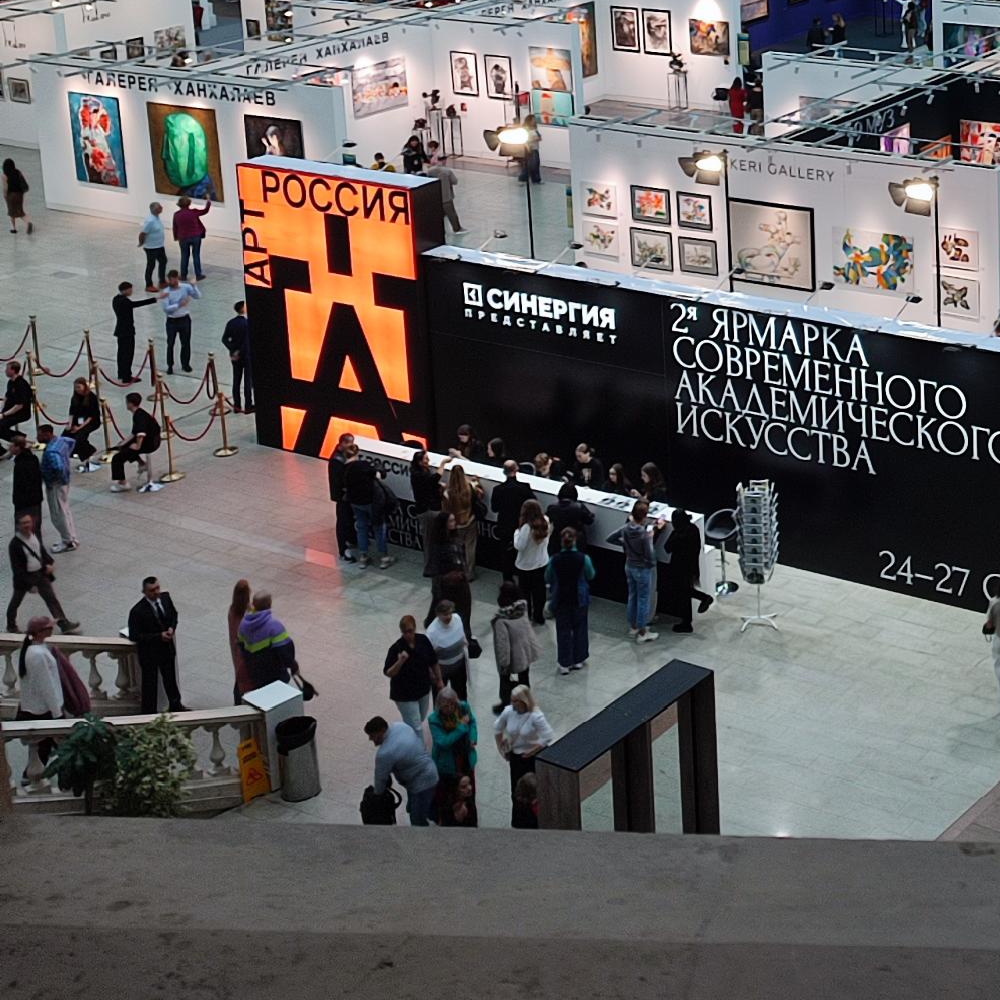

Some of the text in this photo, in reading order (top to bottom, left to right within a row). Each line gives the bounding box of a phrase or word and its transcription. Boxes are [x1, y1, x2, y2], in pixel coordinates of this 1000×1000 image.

[86, 70, 277, 106] ГАЛЕРЕЯ ХАНХАЛАЕВ
[261, 170, 410, 225] РОССИЯ
[767, 163, 835, 182] GALLERY
[240, 199, 271, 287] АРТ
[464, 308, 617, 345] ПРЕДСТАВЛЯЕТ
[486, 288, 616, 330] СИНЕРГИЯ
[709, 308, 870, 367] ЯРМАРКА
[672, 336, 967, 420] СОВРЕМЕННОГО
[676, 403, 876, 475] ИСКУССТВА
